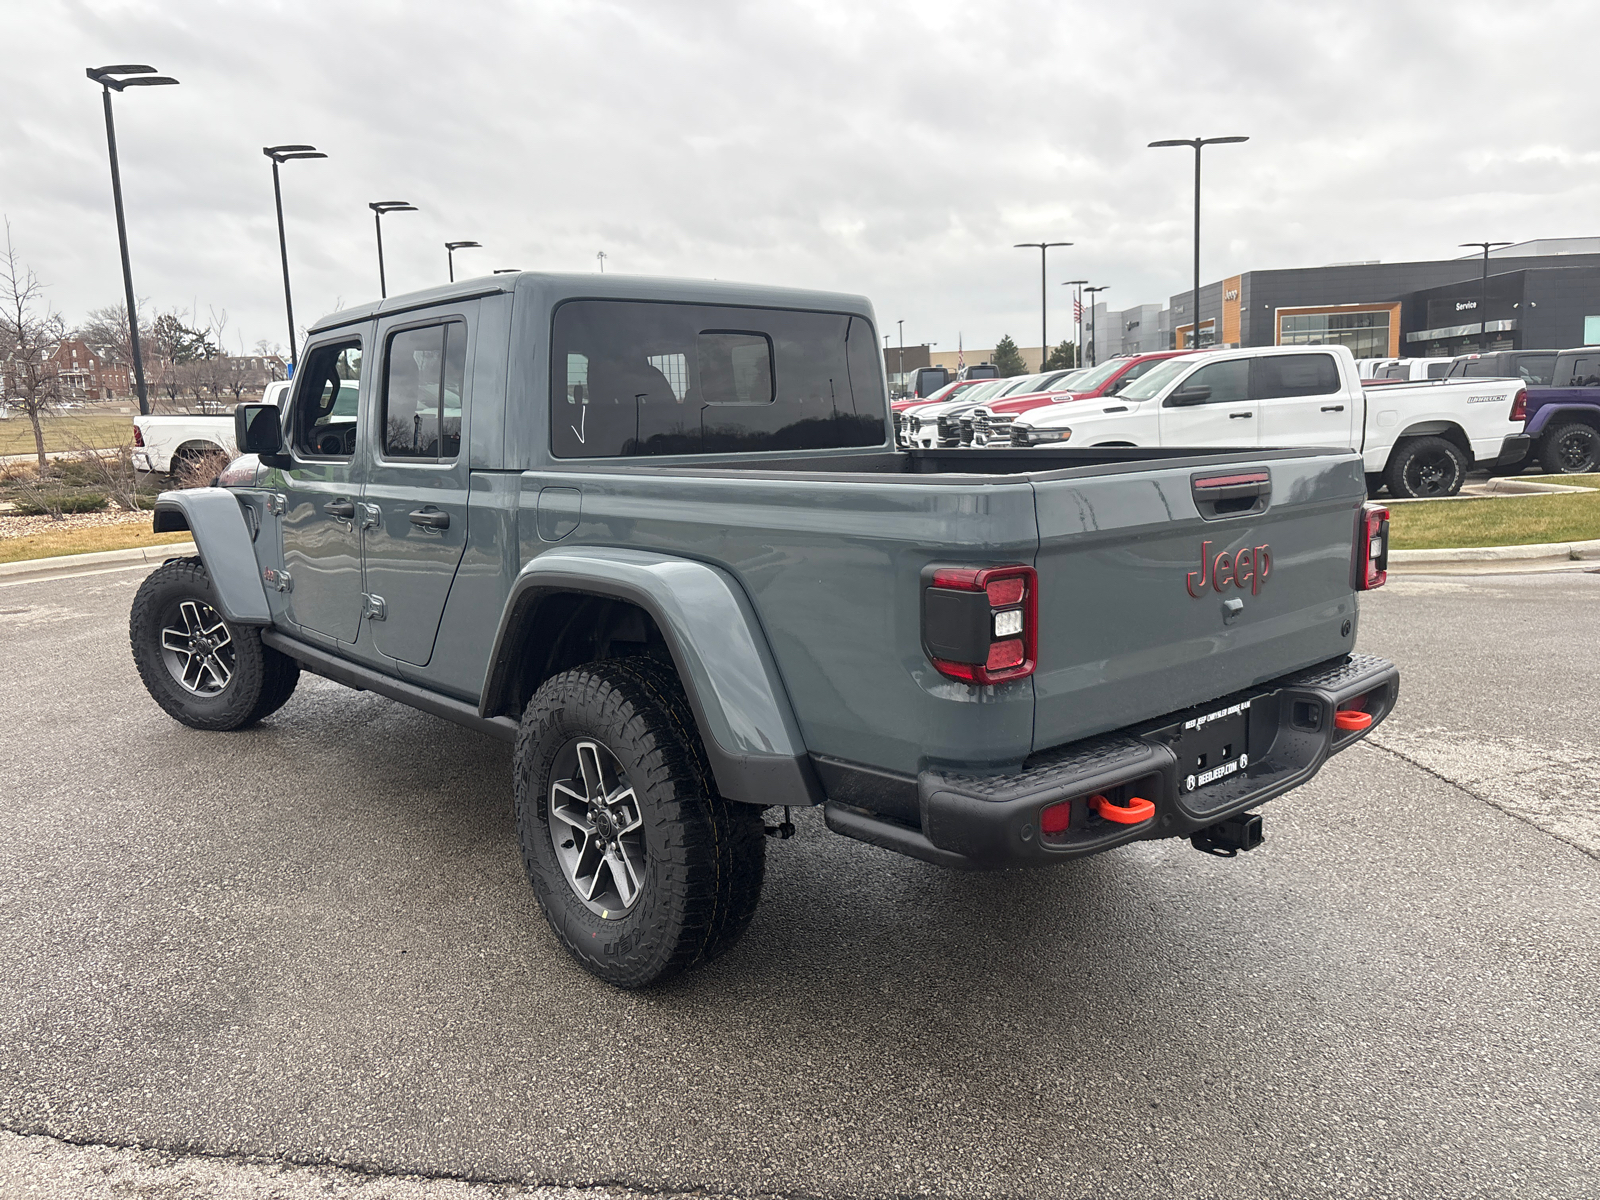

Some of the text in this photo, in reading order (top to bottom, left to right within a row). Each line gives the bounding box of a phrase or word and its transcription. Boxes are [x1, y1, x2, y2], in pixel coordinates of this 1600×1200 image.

[1455, 300, 1477, 311] Service
[1187, 540, 1274, 599] Jeep
[1198, 761, 1238, 787] REEDJEEP.COM
